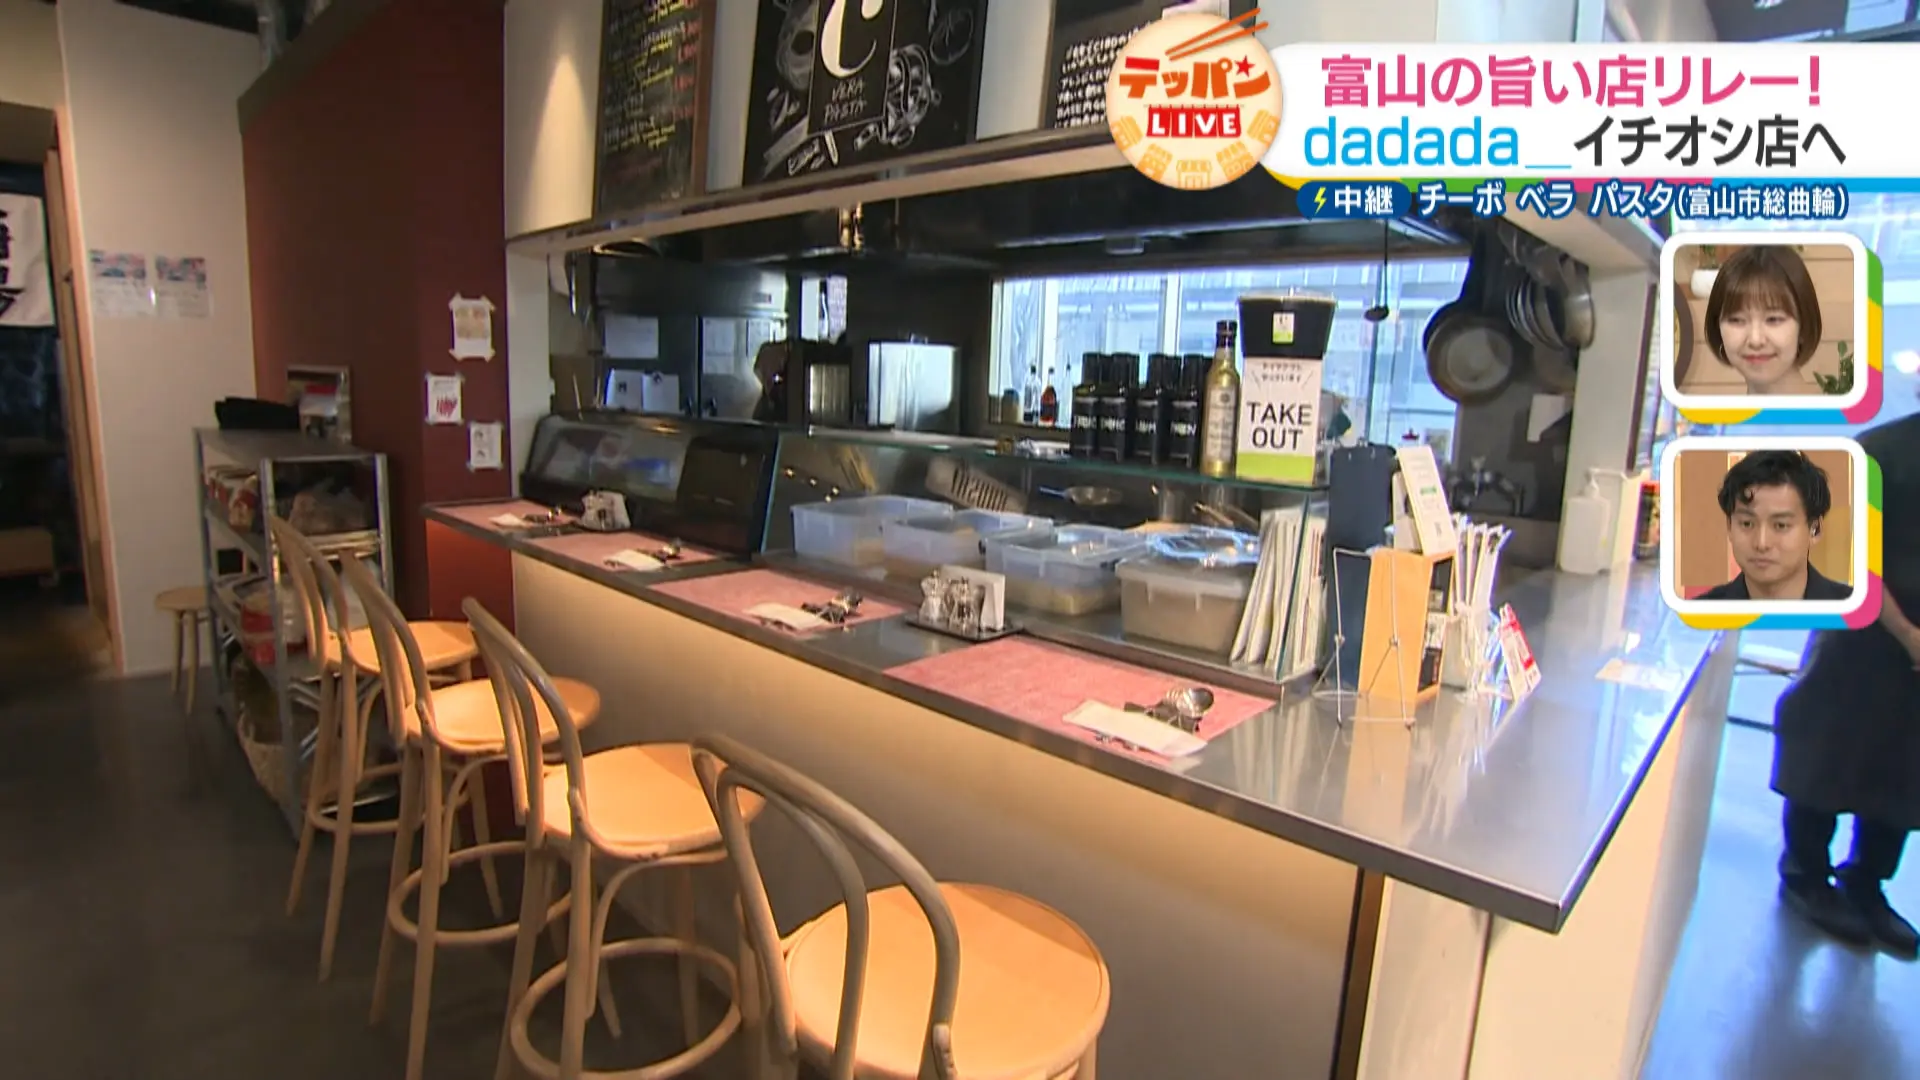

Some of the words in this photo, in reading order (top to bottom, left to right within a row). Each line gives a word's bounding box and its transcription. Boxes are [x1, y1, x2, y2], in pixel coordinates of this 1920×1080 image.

[831, 78, 864, 101] VERA
[824, 100, 866, 123] PASTA
[1247, 401, 1312, 427] TAKE
[1252, 427, 1303, 450] OUT
